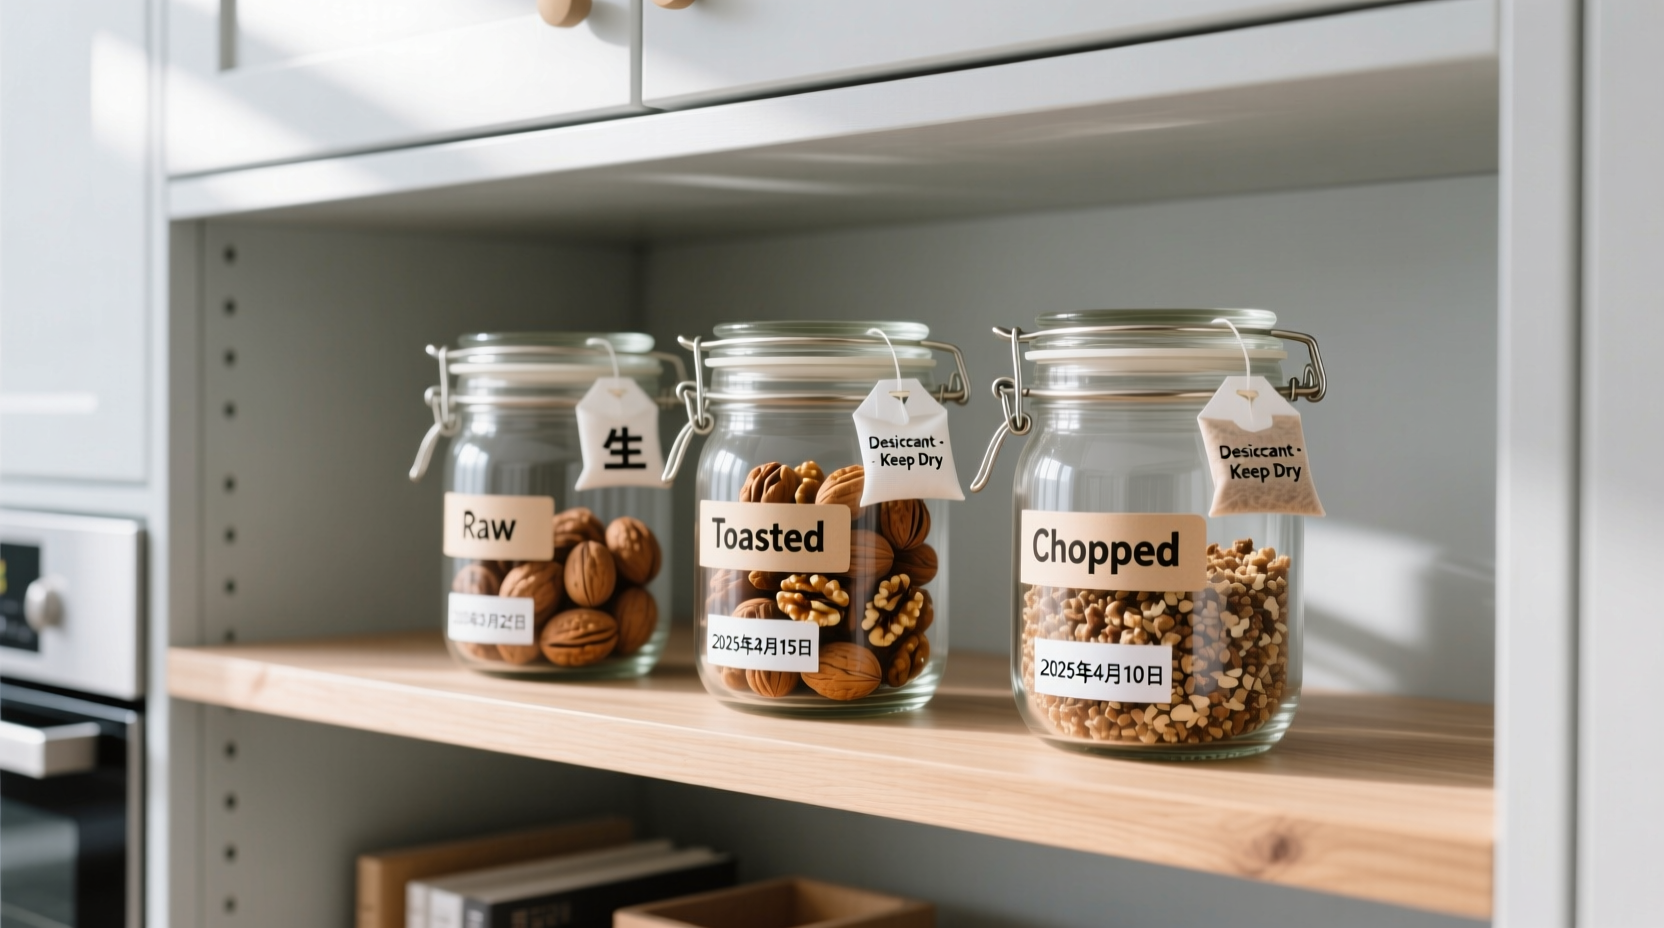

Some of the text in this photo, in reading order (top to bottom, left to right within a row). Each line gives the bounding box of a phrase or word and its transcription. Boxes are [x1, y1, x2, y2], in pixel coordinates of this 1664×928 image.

[603, 427, 647, 470] 生
[869, 435, 936, 449] Desiccant
[1219, 444, 1294, 459] Desiccant
[880, 453, 943, 471] Keep Dry
[1230, 463, 1301, 483] Keep Dry
[463, 511, 516, 542] Raw
[712, 517, 824, 552] Toasted
[1032, 528, 1180, 575] Chopped
[1040, 658, 1163, 686] 2025年4月10日
